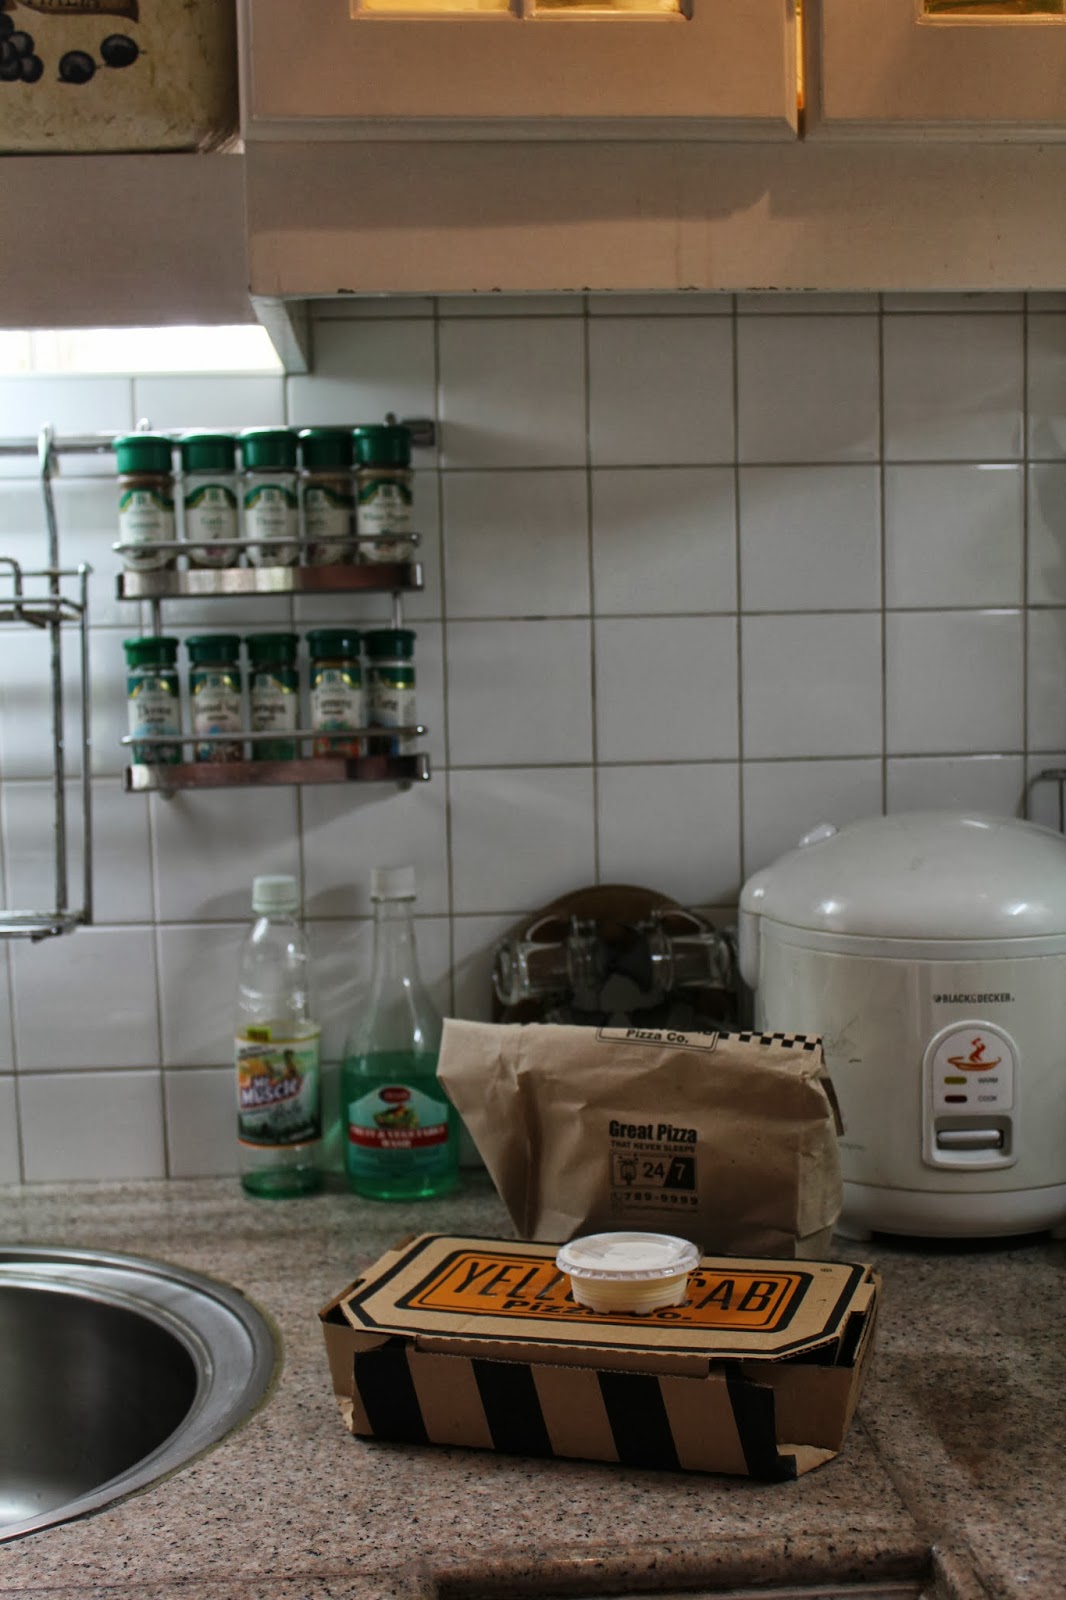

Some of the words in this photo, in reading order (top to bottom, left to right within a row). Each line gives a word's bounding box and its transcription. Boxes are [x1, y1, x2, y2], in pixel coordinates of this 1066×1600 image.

[626, 1029, 662, 1041] Pizza
[667, 1032, 688, 1044] Co.
[609, 1120, 653, 1140] Great
[657, 1124, 697, 1143] Pizza
[454, 1262, 575, 1302] YELL
